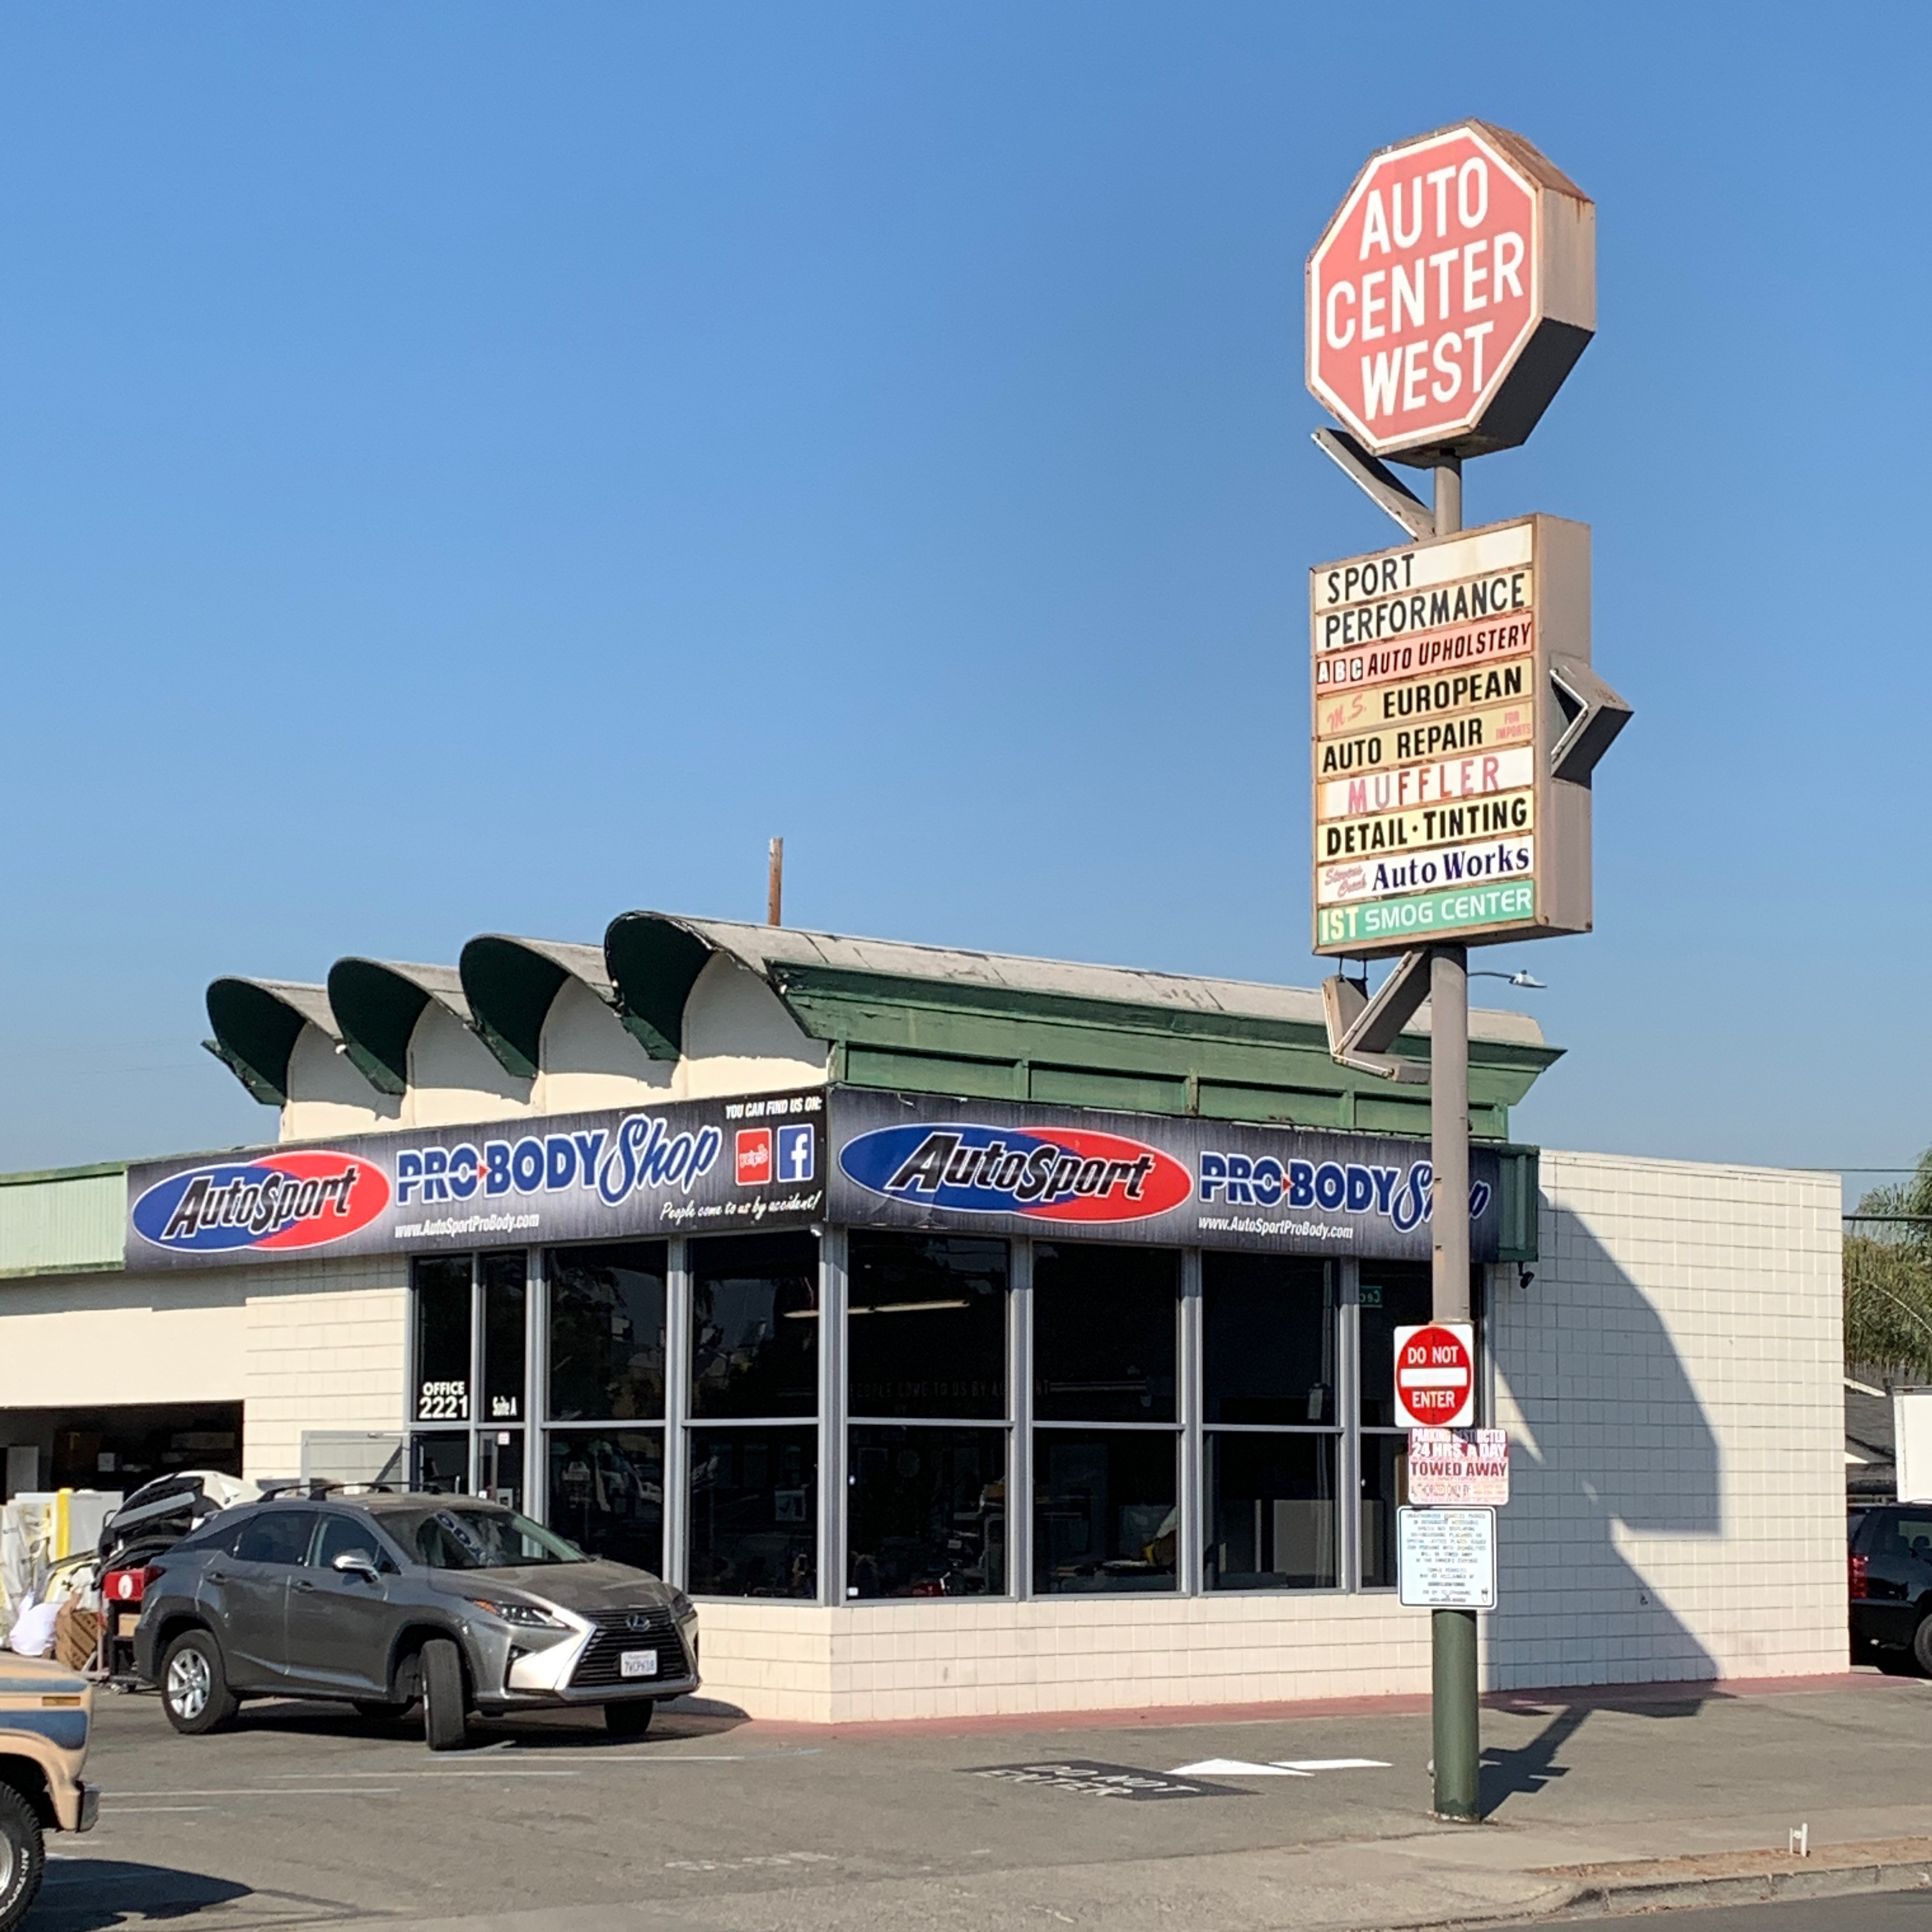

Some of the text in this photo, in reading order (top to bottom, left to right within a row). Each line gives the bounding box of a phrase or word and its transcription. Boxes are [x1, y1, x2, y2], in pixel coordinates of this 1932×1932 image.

[1359, 157, 1488, 261] AUTO
[1326, 231, 1524, 349] CENTER
[1361, 321, 1494, 420] WEST
[1327, 553, 1414, 604] SPORT
[1326, 572, 1525, 648] PERFORMANCE
[1367, 647, 1412, 677] AUTO
[1419, 622, 1532, 666] UPHOLSTERY
[1383, 666, 1522, 719] EUROPEAN
[1322, 717, 1483, 772] AUTO REPAIR
[1348, 756, 1499, 814] MUFFLER
[1327, 798, 1527, 856] DETAIL TINTING
[1372, 857, 1437, 891] Auto
[1443, 844, 1529, 880] Works
[1365, 901, 1434, 931] SMOG
[1441, 887, 1531, 919] CENTER
[726, 1103, 744, 1119] YOU
[745, 1101, 765, 1117] CAN
[766, 1099, 788, 1116] FIND
[790, 1098, 803, 1113] US
[484, 1128, 608, 1199] BODY
[599, 1114, 722, 1208] Shop
[883, 1131, 1156, 1202] AutoSport
[1287, 1158, 1401, 1215] BODY
[160, 1165, 360, 1240] AutoSport
[394, 1213, 540, 1238] www.AutoSportProBody.com
[659, 1199, 696, 1226] People
[698, 1204, 723, 1217] come
[724, 1201, 737, 1215] to
[737, 1202, 751, 1215] us
[751, 1195, 765, 1221] by
[1198, 1216, 1354, 1240] www.AutoSportProBody.com
[1407, 1346, 1459, 1364] DO NOT
[418, 1395, 468, 1419] 2221
[422, 1381, 465, 1396] OFFICE
[1412, 1391, 1455, 1408] ENTER
[1411, 1462, 1506, 1476] TOWED AWAY
[1412, 1443, 1430, 1457] 24
[1467, 1443, 1478, 1457] A
[1479, 1443, 1506, 1457] DAY
